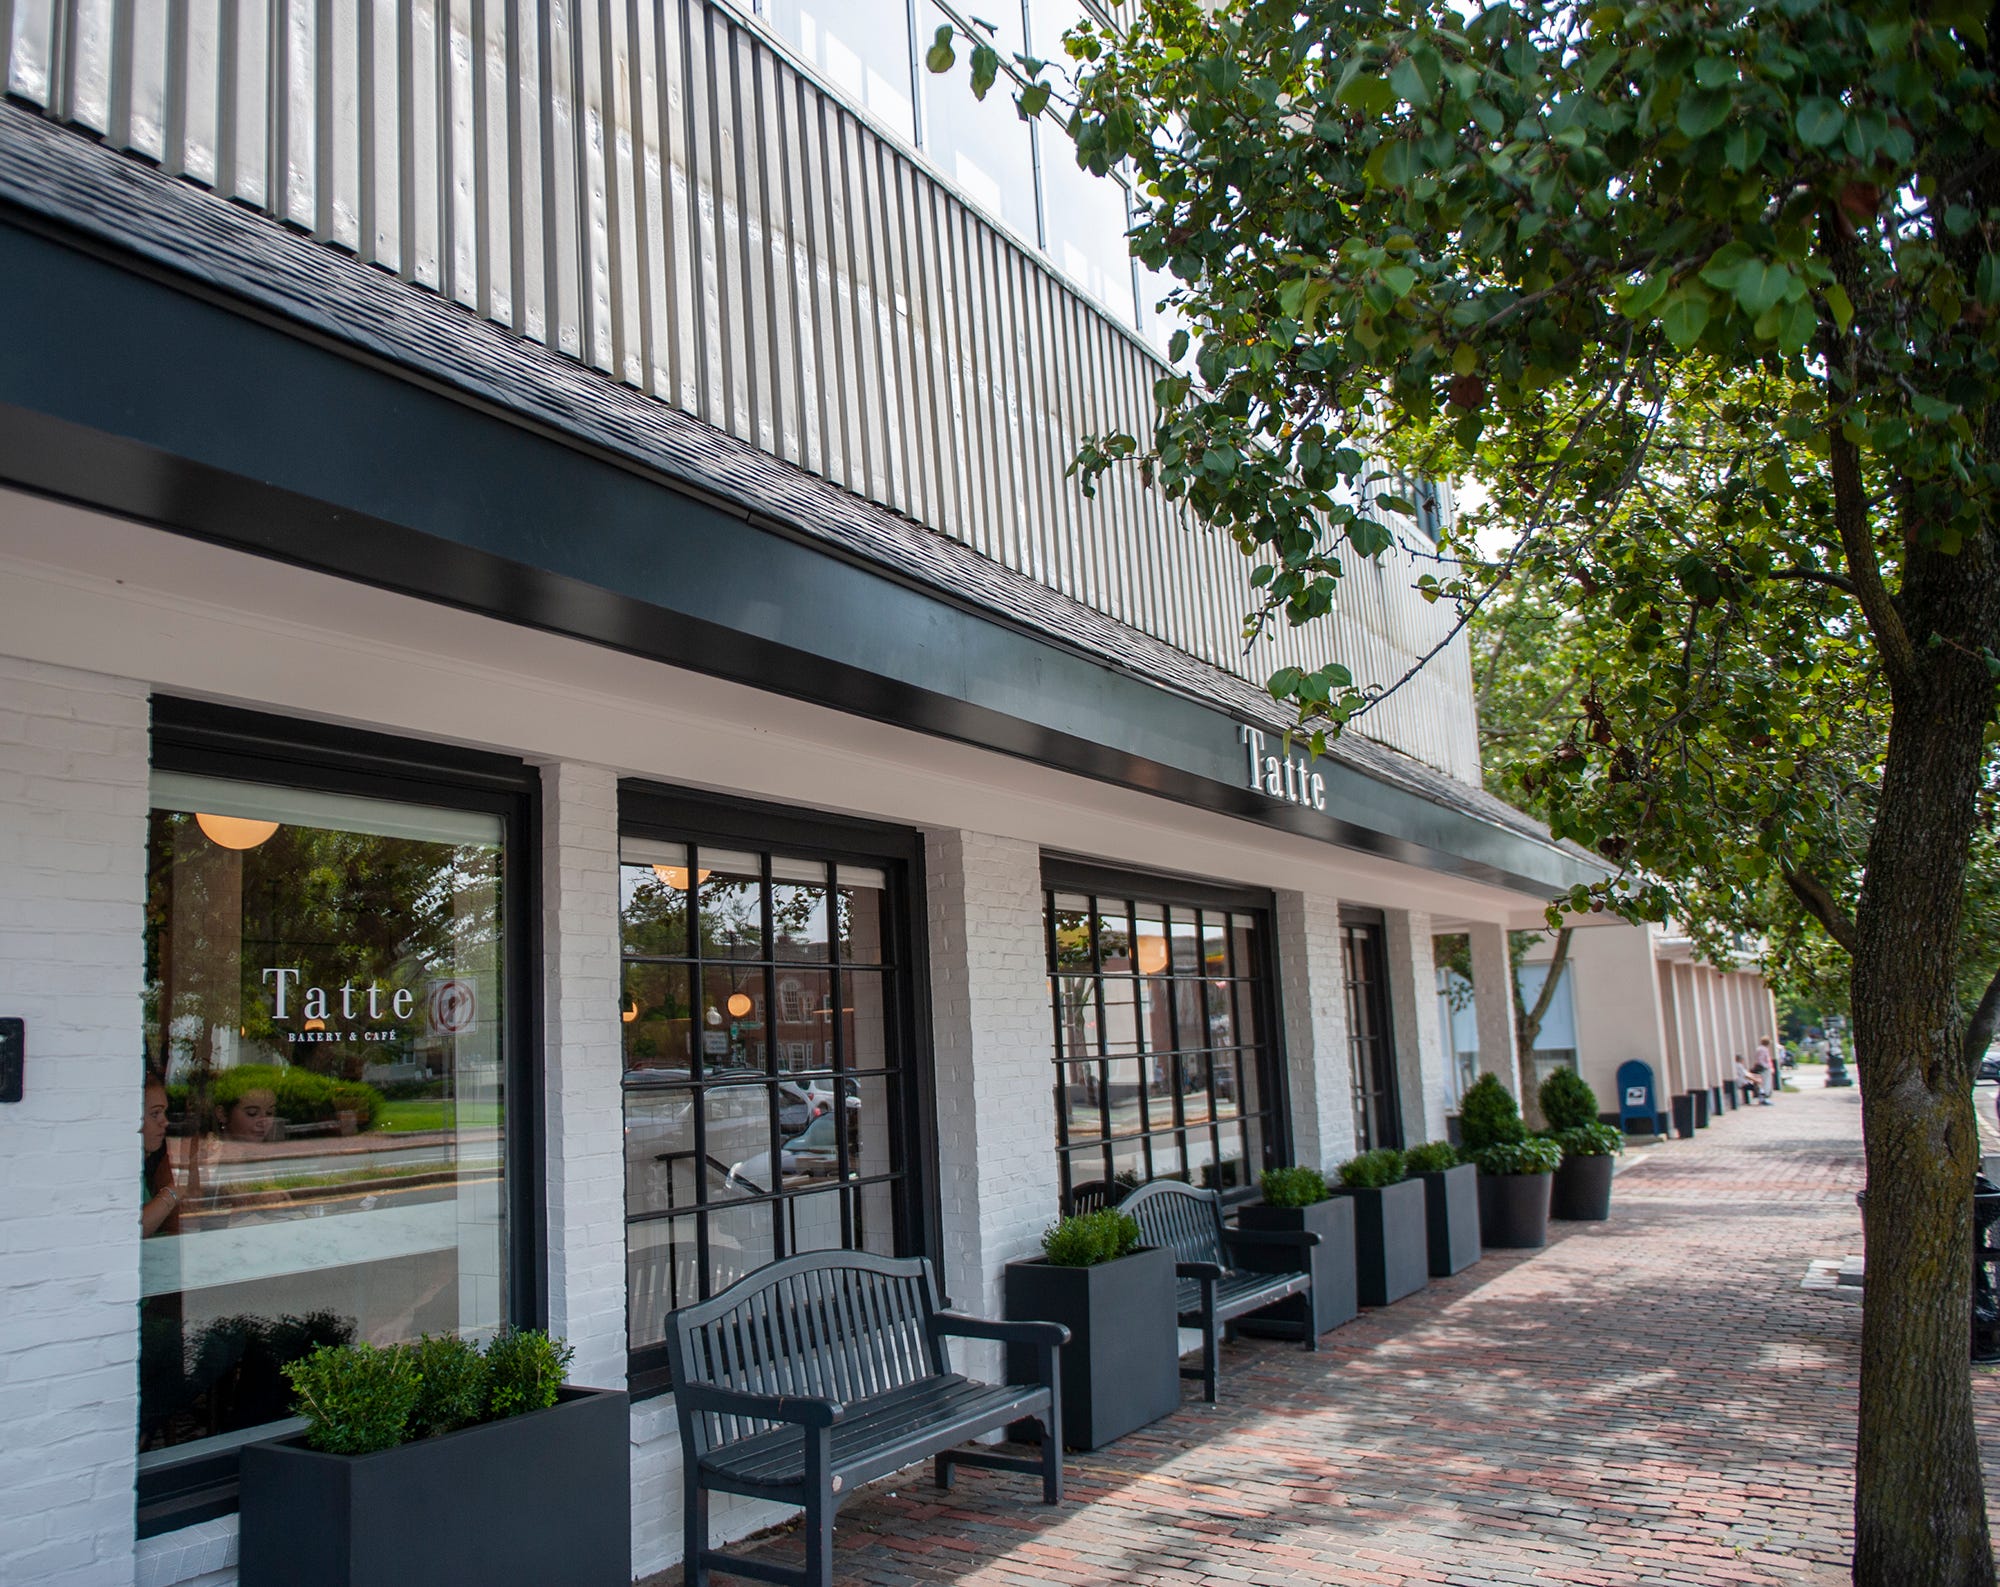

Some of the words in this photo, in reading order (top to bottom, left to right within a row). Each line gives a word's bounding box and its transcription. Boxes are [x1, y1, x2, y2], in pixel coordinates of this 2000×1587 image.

[1241, 724, 1326, 811] Tatte
[262, 968, 413, 1019] Tatte
[288, 1031, 342, 1042] BAKERY
[349, 1032, 357, 1041] &
[364, 1029, 397, 1041] CAFÉ
